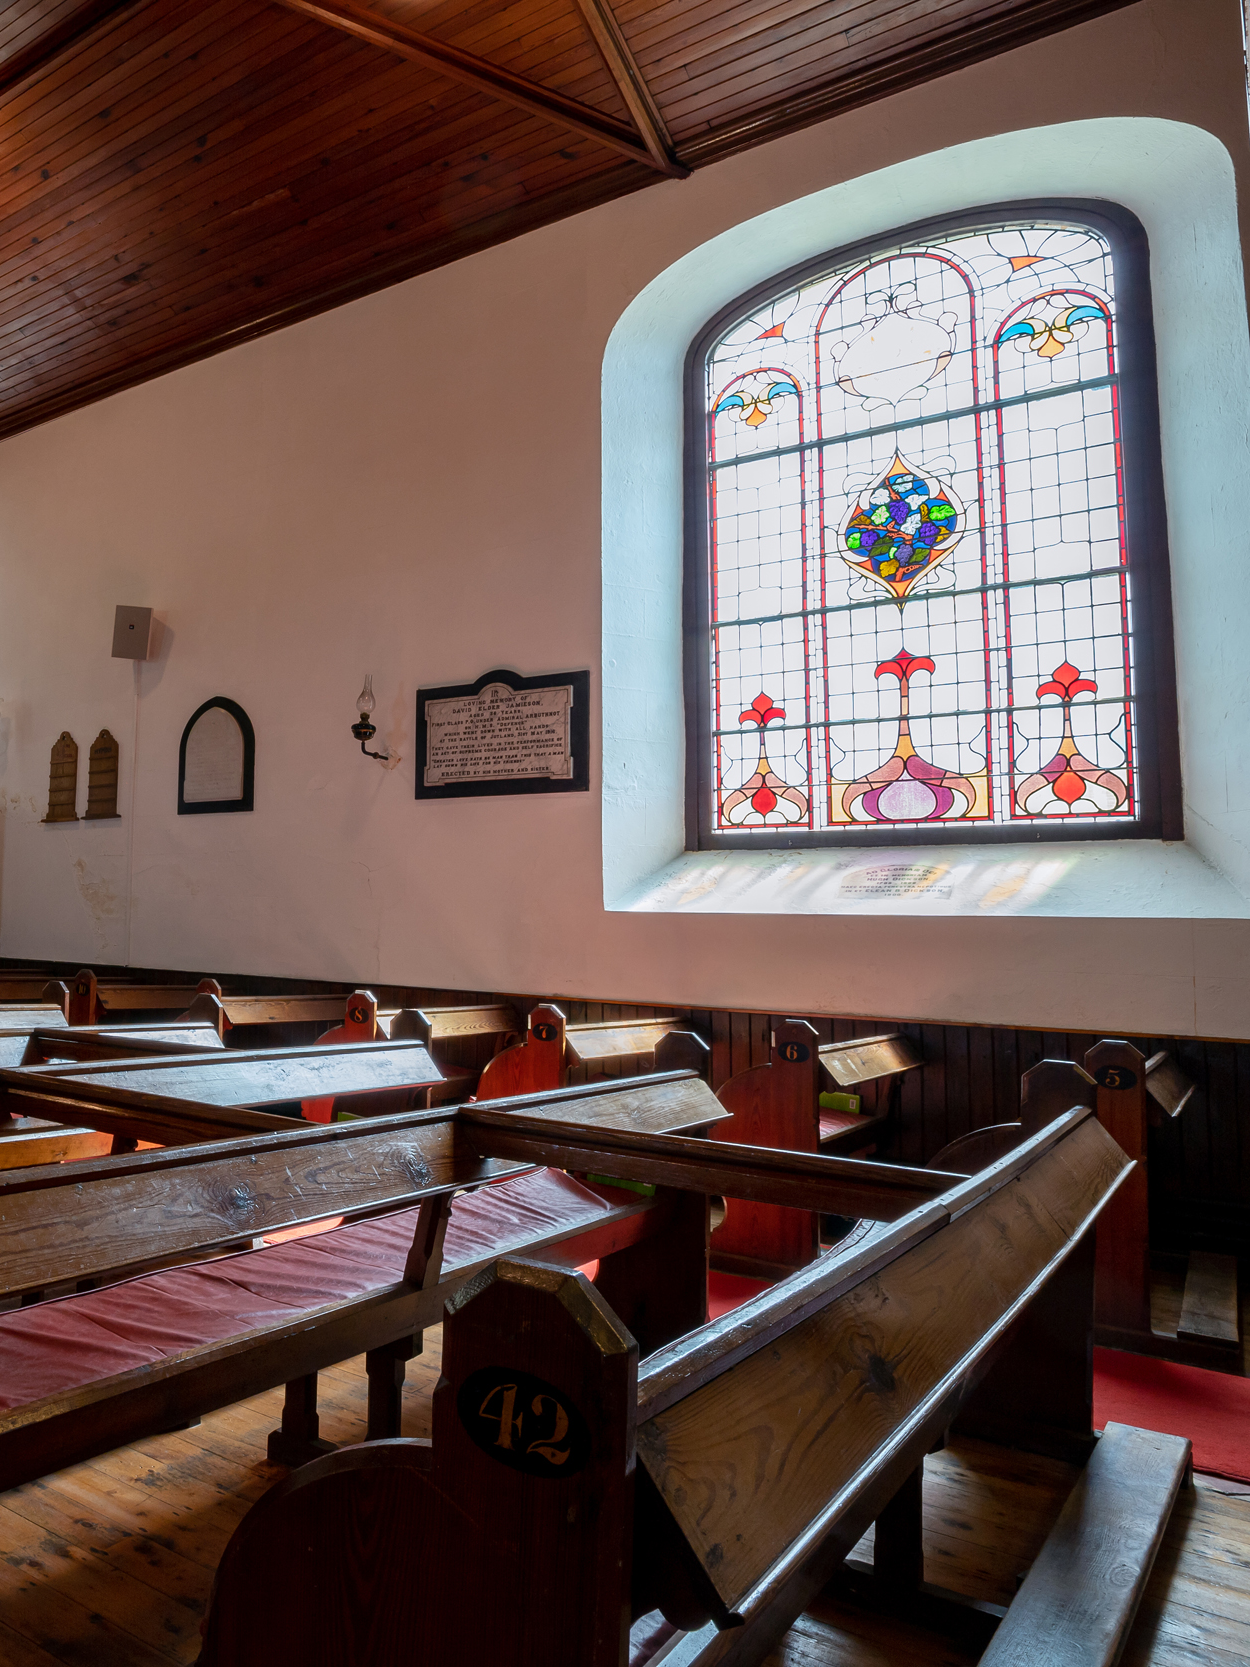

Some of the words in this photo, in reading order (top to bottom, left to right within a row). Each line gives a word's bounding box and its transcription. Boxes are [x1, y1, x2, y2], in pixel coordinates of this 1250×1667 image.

[490, 696, 516, 704] MEMORY
[526, 711, 560, 719] ARBUTHNOT
[354, 1008, 363, 1023] 8
[539, 1025, 549, 1039] 7
[786, 1044, 798, 1061] 6
[1105, 1069, 1121, 1088] 5
[479, 1383, 571, 1465] 42
